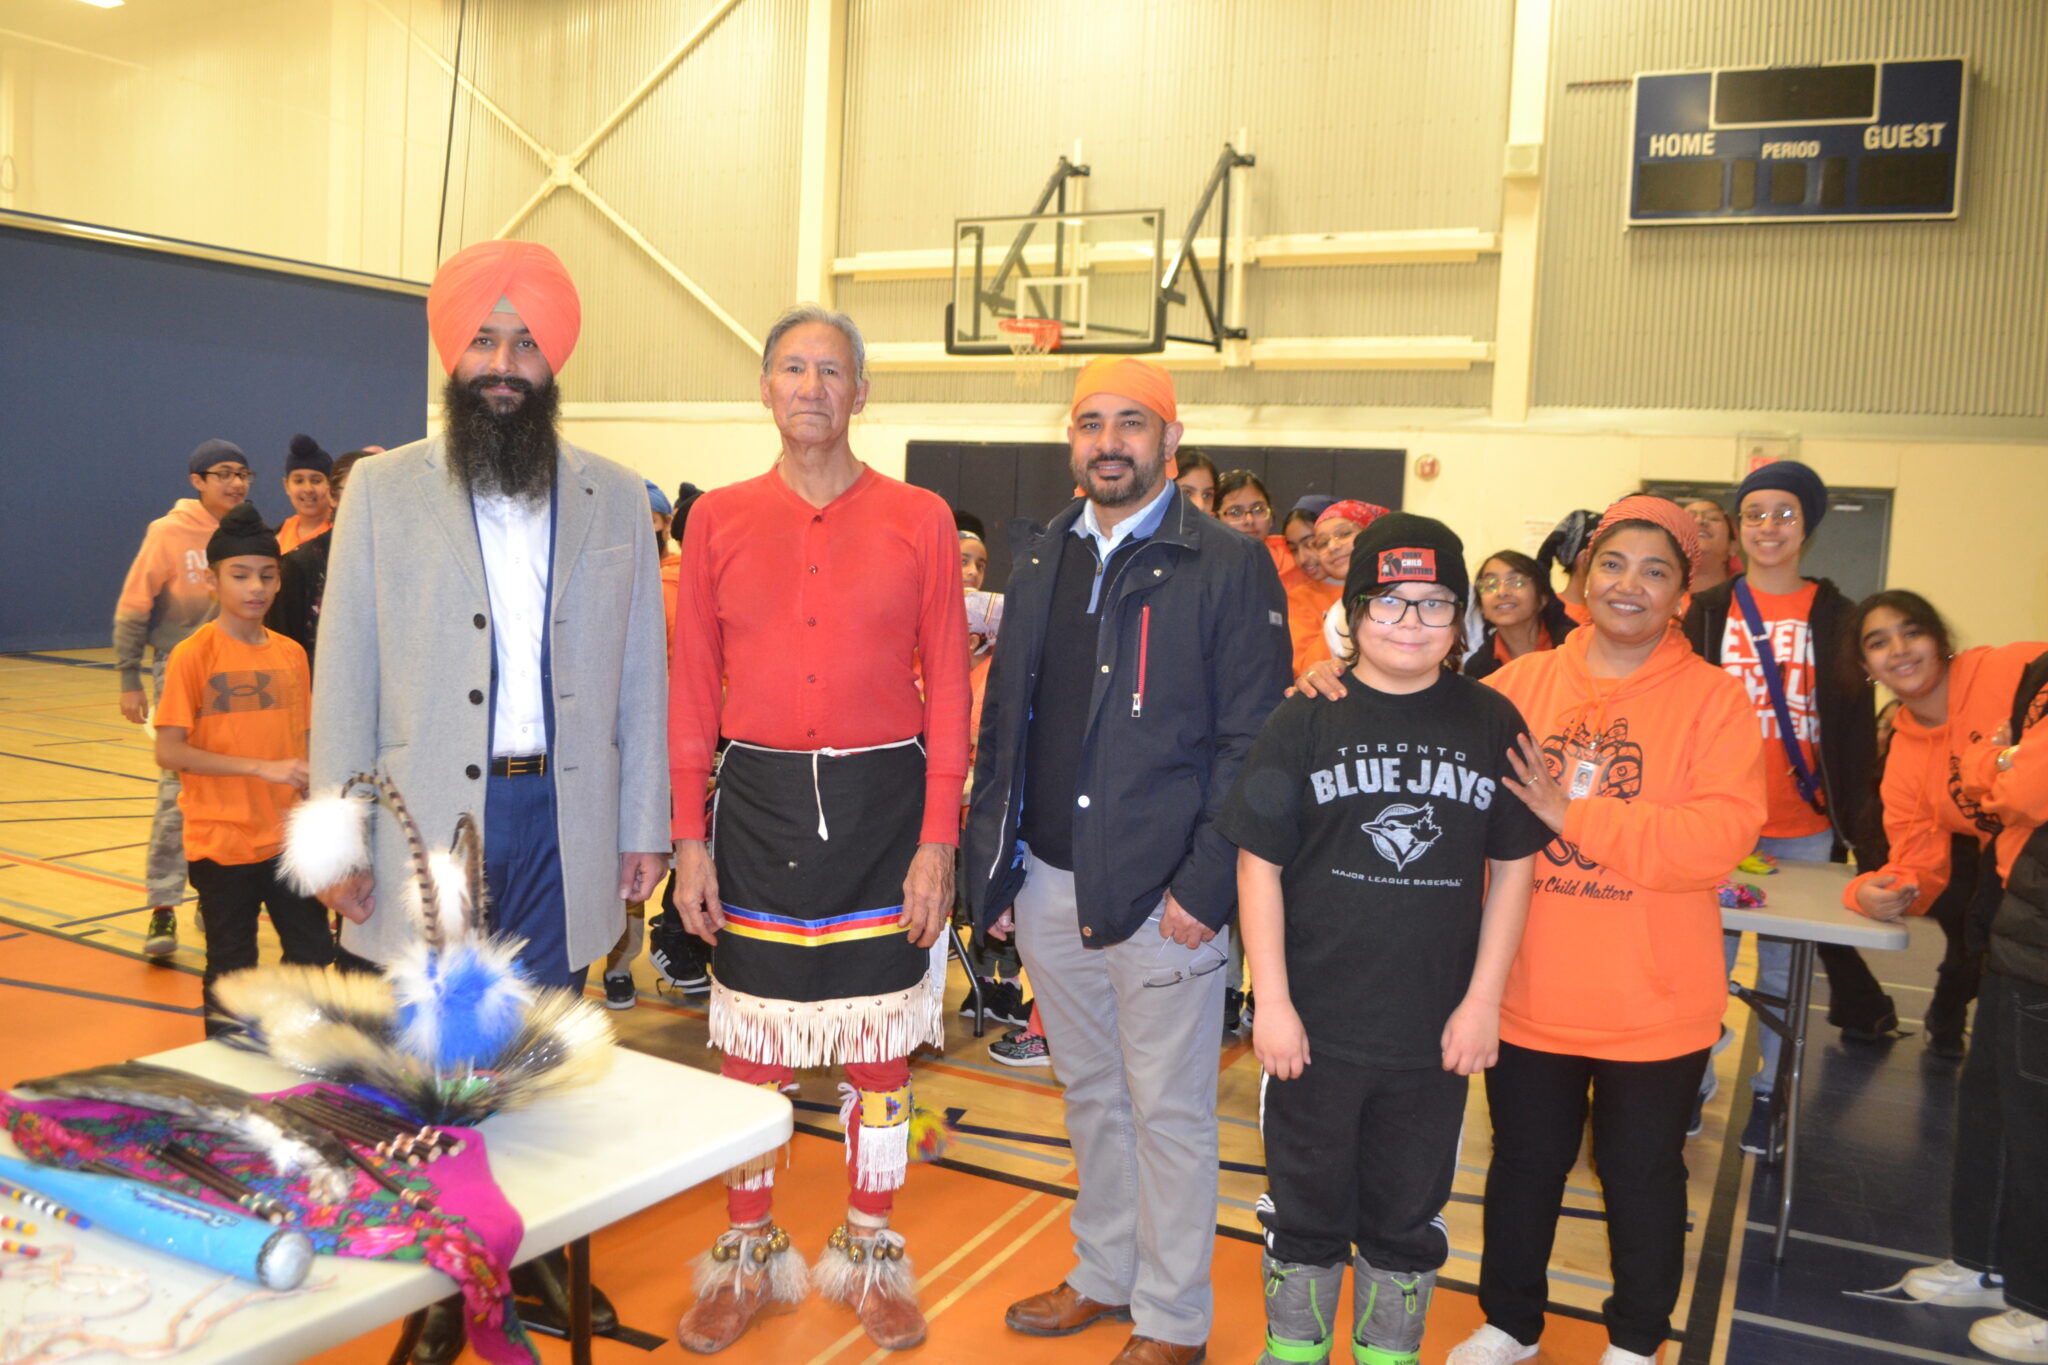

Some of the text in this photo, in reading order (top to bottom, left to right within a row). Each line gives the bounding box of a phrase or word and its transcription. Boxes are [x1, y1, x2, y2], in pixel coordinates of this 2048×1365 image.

[1649, 132, 1716, 158] HOME
[1863, 122, 1948, 151] GUEST
[1761, 139, 1821, 160] PERIOD
[1401, 558, 1423, 567] CHILD
[1338, 743, 1466, 762] TORONTO
[1310, 757, 1496, 811] BLUE JAYS
[1331, 868, 1461, 887] MAJOR LEAGUE BASEBALL
[1544, 875, 1581, 896] Child
[1580, 880, 1633, 901] Matters
